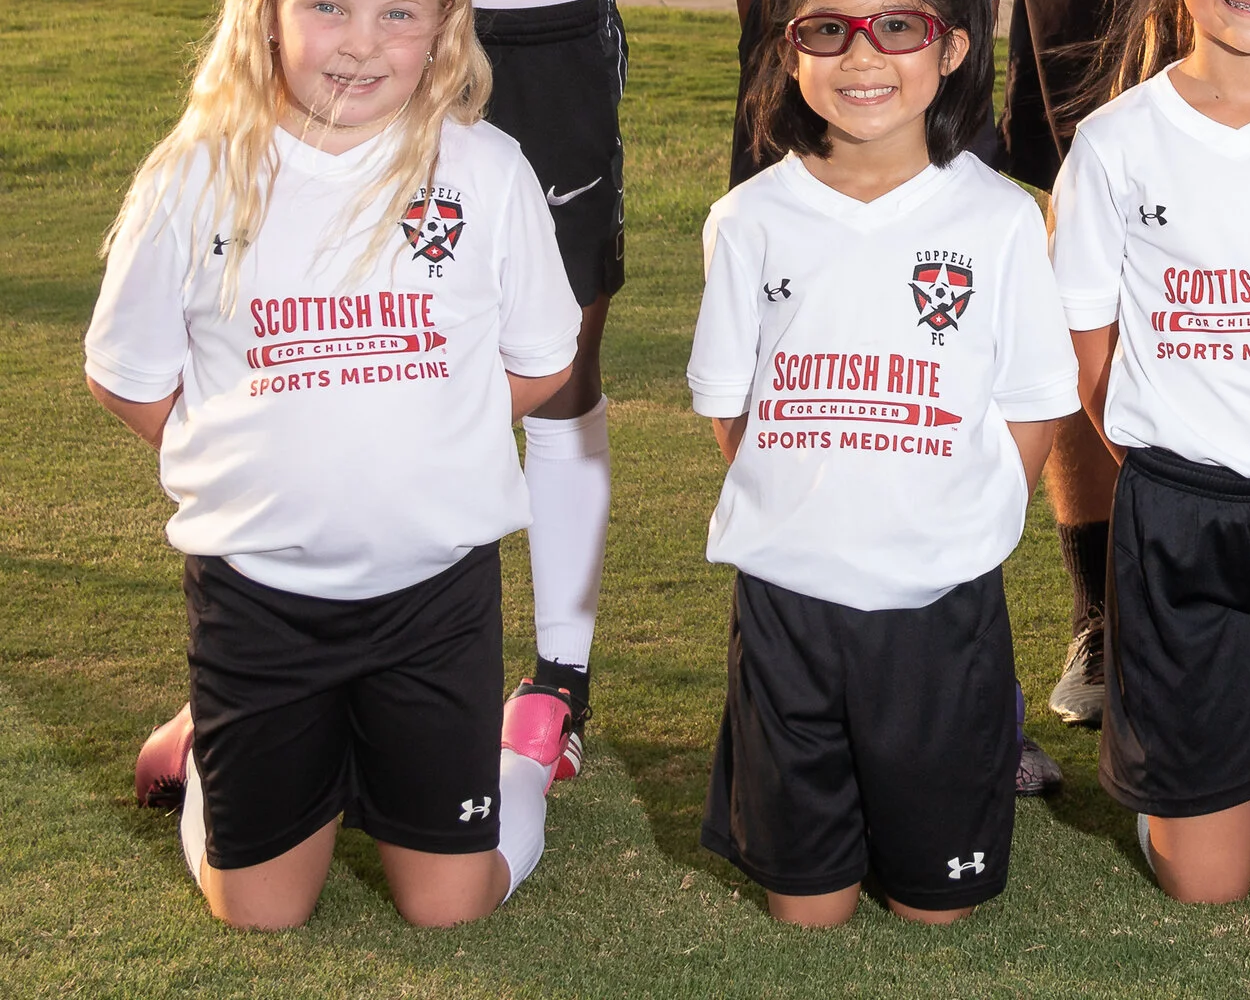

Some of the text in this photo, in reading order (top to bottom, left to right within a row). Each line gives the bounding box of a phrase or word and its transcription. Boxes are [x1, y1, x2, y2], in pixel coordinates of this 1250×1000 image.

[412, 187, 462, 202] PPELL
[916, 250, 973, 269] COPPELL
[428, 264, 443, 278] FC
[250, 291, 435, 338] SCOTTISH RITE
[1187, 317, 1209, 328] FOR
[931, 332, 945, 346] FC
[277, 339, 399, 359] FOR CHILDREN
[1157, 342, 1234, 360] SPORTS
[250, 361, 449, 396] SPORTS MEDICINE
[773, 351, 941, 398] SCOTTISH RITE
[790, 405, 900, 417] FOR CHILDREN
[757, 431, 953, 457] SPORTS MEDICINE
